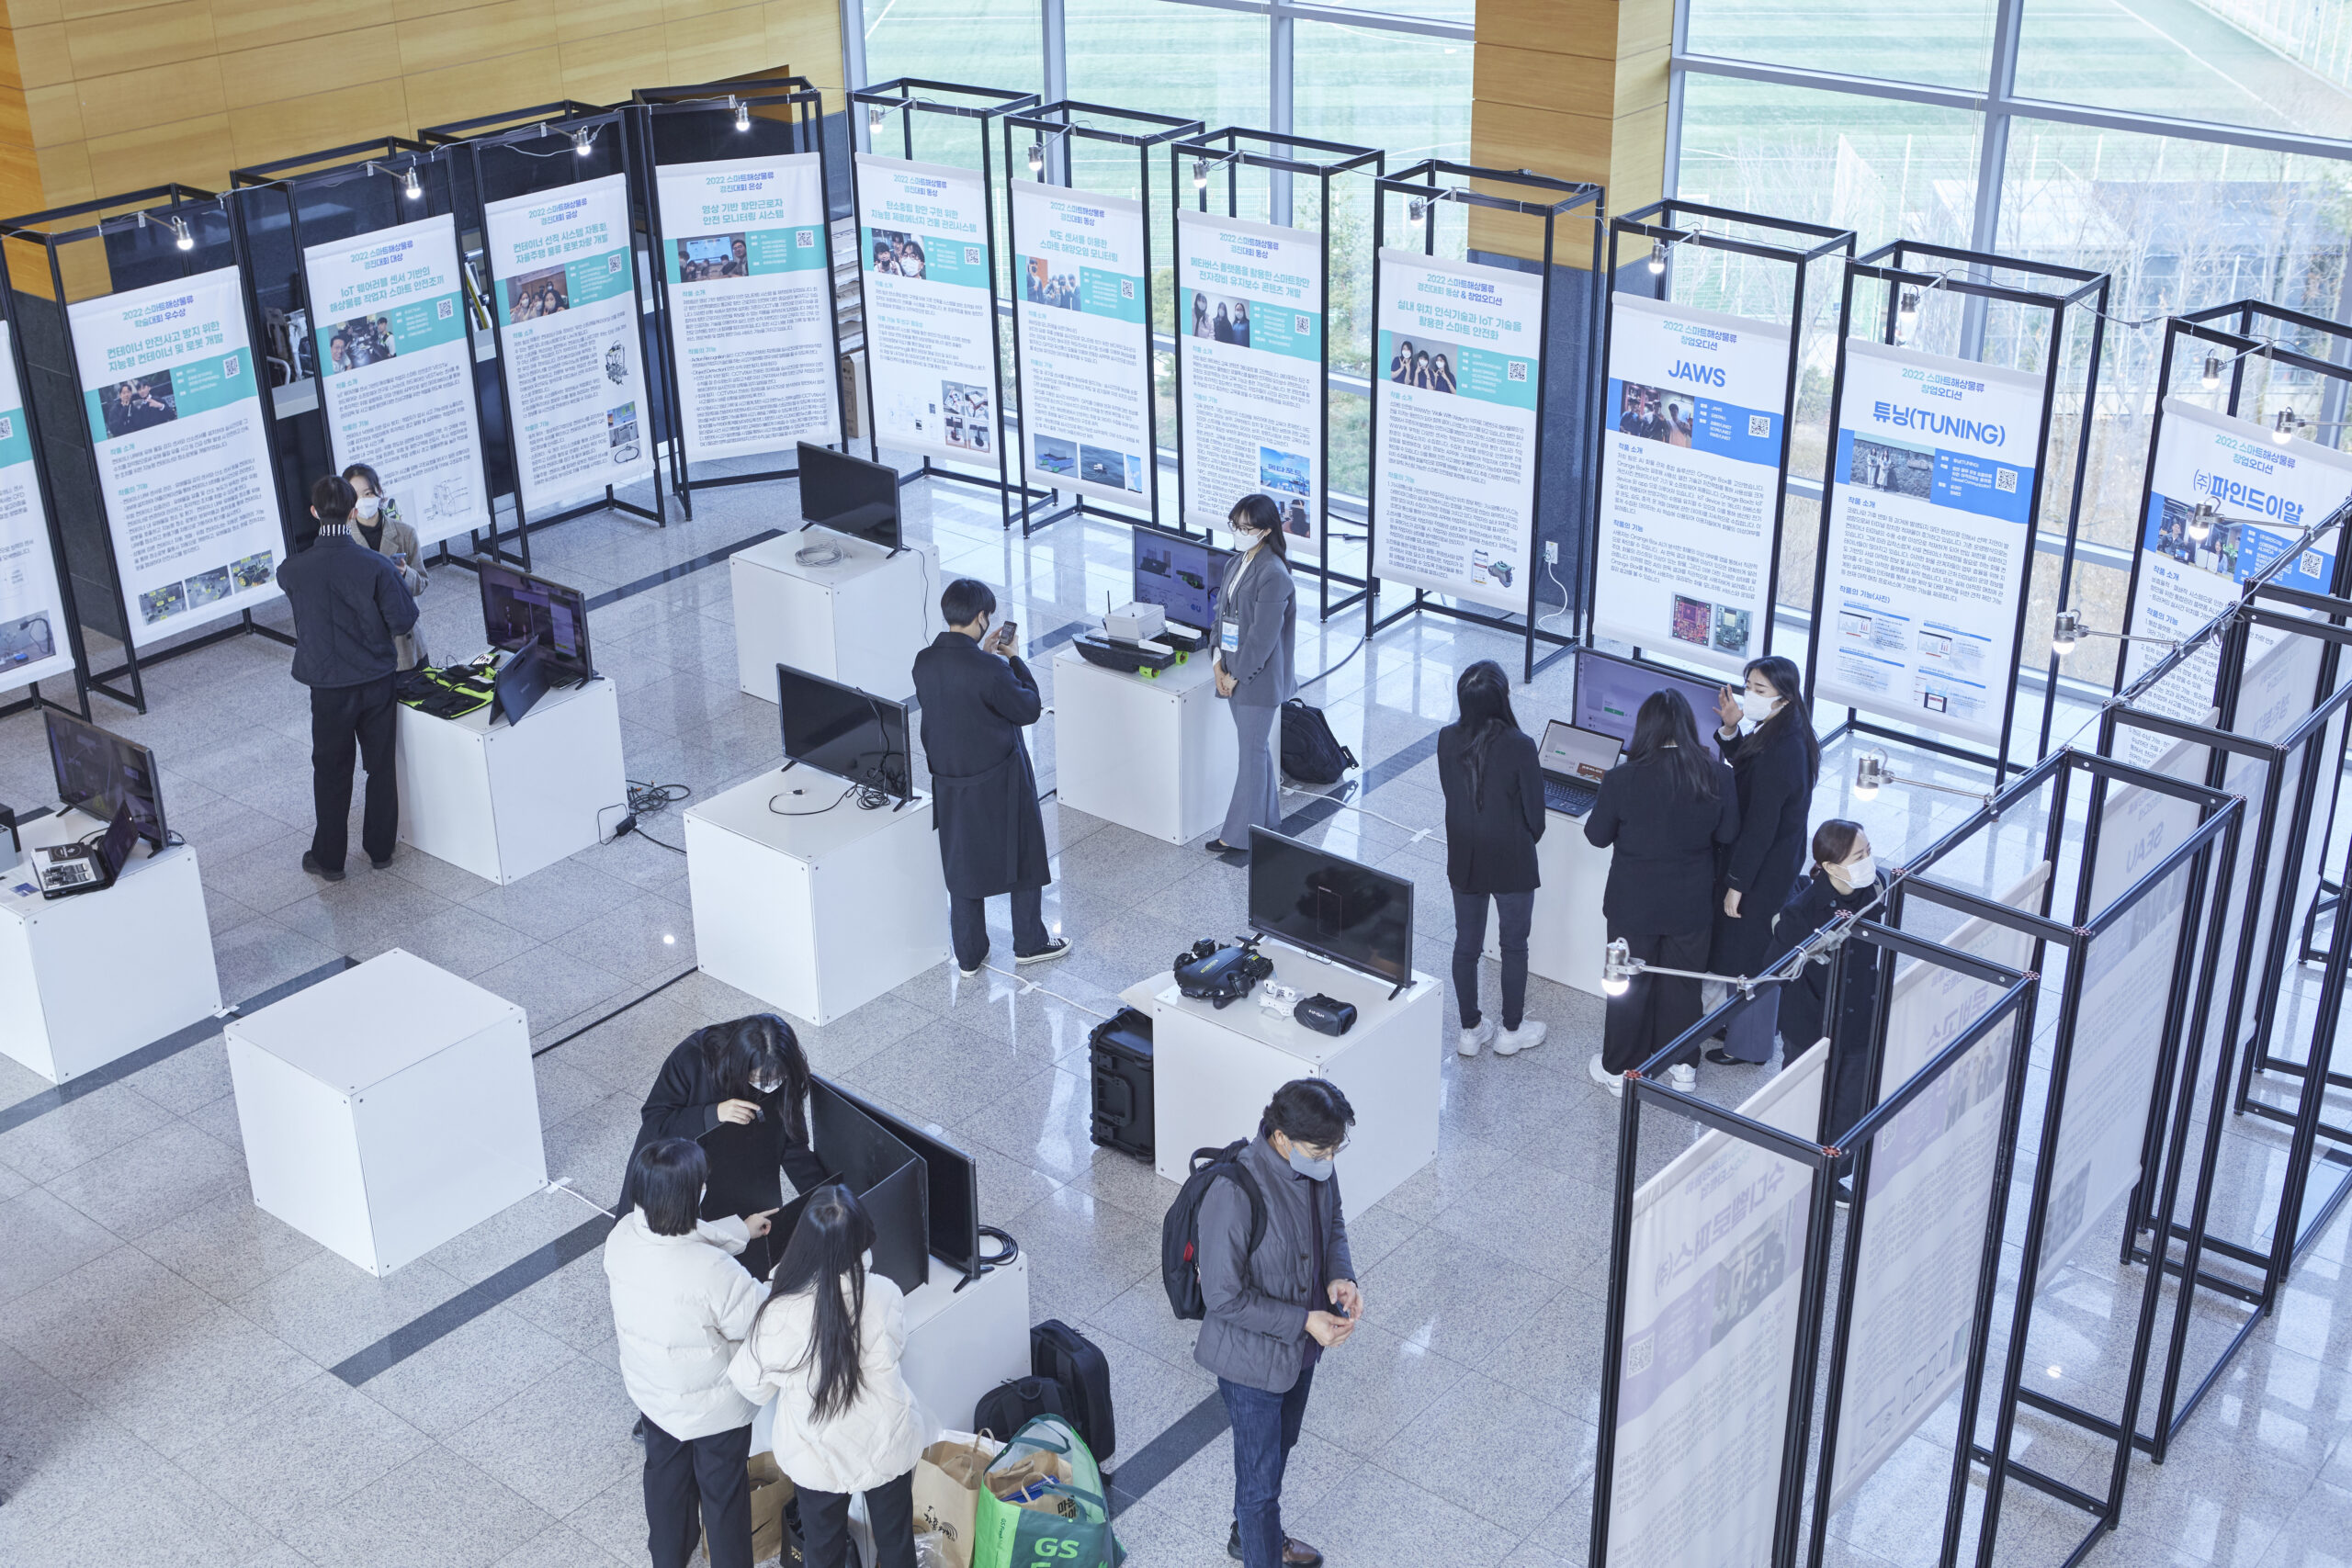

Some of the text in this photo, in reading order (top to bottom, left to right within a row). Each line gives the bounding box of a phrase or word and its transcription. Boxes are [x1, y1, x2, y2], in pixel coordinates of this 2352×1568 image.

[706, 172, 775, 185] 2022 스마트해상물류
[894, 175, 908, 184] 2022
[529, 208, 546, 219] 2022
[702, 198, 783, 214] 영상 기반 항만근로자
[915, 205, 928, 215] 항만
[930, 207, 943, 217] 구현
[944, 209, 958, 220] 위한
[1050, 201, 1065, 211] 2022
[703, 209, 784, 225] 안전 모니터링 시스템
[514, 238, 543, 253] 컨테이너
[562, 228, 583, 241] 시스템
[1087, 237, 1107, 249] 이용한
[1219, 232, 1236, 243] 2022
[350, 252, 368, 263] 2022
[390, 253, 402, 263] 대상
[516, 249, 546, 264] 자율주행
[548, 245, 561, 256] 물류
[594, 233, 608, 244] 개발
[1040, 240, 1060, 252] 스마트
[1091, 249, 1117, 262] 모니터링
[341, 265, 430, 298] IoT 웨어러블 센서 기반의
[1191, 257, 1219, 270] 메타버스
[1250, 268, 1272, 280] 활용한
[1273, 274, 1310, 288] 스마트항만
[330, 275, 444, 312] 해상물류 작업자 스마트 안전조끼
[1200, 271, 1301, 299] 전자장비 유지보수 콘텐츠 개발
[1427, 274, 1494, 293] 2022 스마트해상물류
[1418, 283, 1444, 294] 경진대회
[1446, 288, 1460, 298] 동상
[1468, 292, 1502, 306] 창업오디션
[122, 295, 194, 321] 2022 스마트해상물류
[164, 309, 186, 321] 우수상
[1397, 300, 1521, 332] 실내 위치 인식기술과 IoT 기술을
[1419, 316, 1498, 340] 활용한 스마트 안전화
[1663, 321, 1736, 344] 2022 스마트해상물류
[107, 321, 220, 359] 컨테이너 안전사고 방지 위한
[1681, 335, 1717, 351] 창업오디션
[108, 333, 223, 372] 지능형 컨테이너 및 로봇 개발
[1668, 360, 1725, 387] JAWS
[1902, 368, 1984, 392] 2022 스마트해상물류
[1921, 385, 1962, 400] 창업오디션
[1873, 401, 2005, 446] 튜닝(TUNING)
[2215, 434, 2295, 468] 2022 스마트해상물류
[2233, 454, 2273, 475] 창업오디션
[1849, 497, 1875, 508] 작품 소개
[2154, 566, 2179, 581] 작품 소개
[1839, 585, 1890, 604] 작품의 기능(사진)
[2147, 607, 2178, 626] 작품의 기능
[1035, 1537, 1080, 1559] GS
